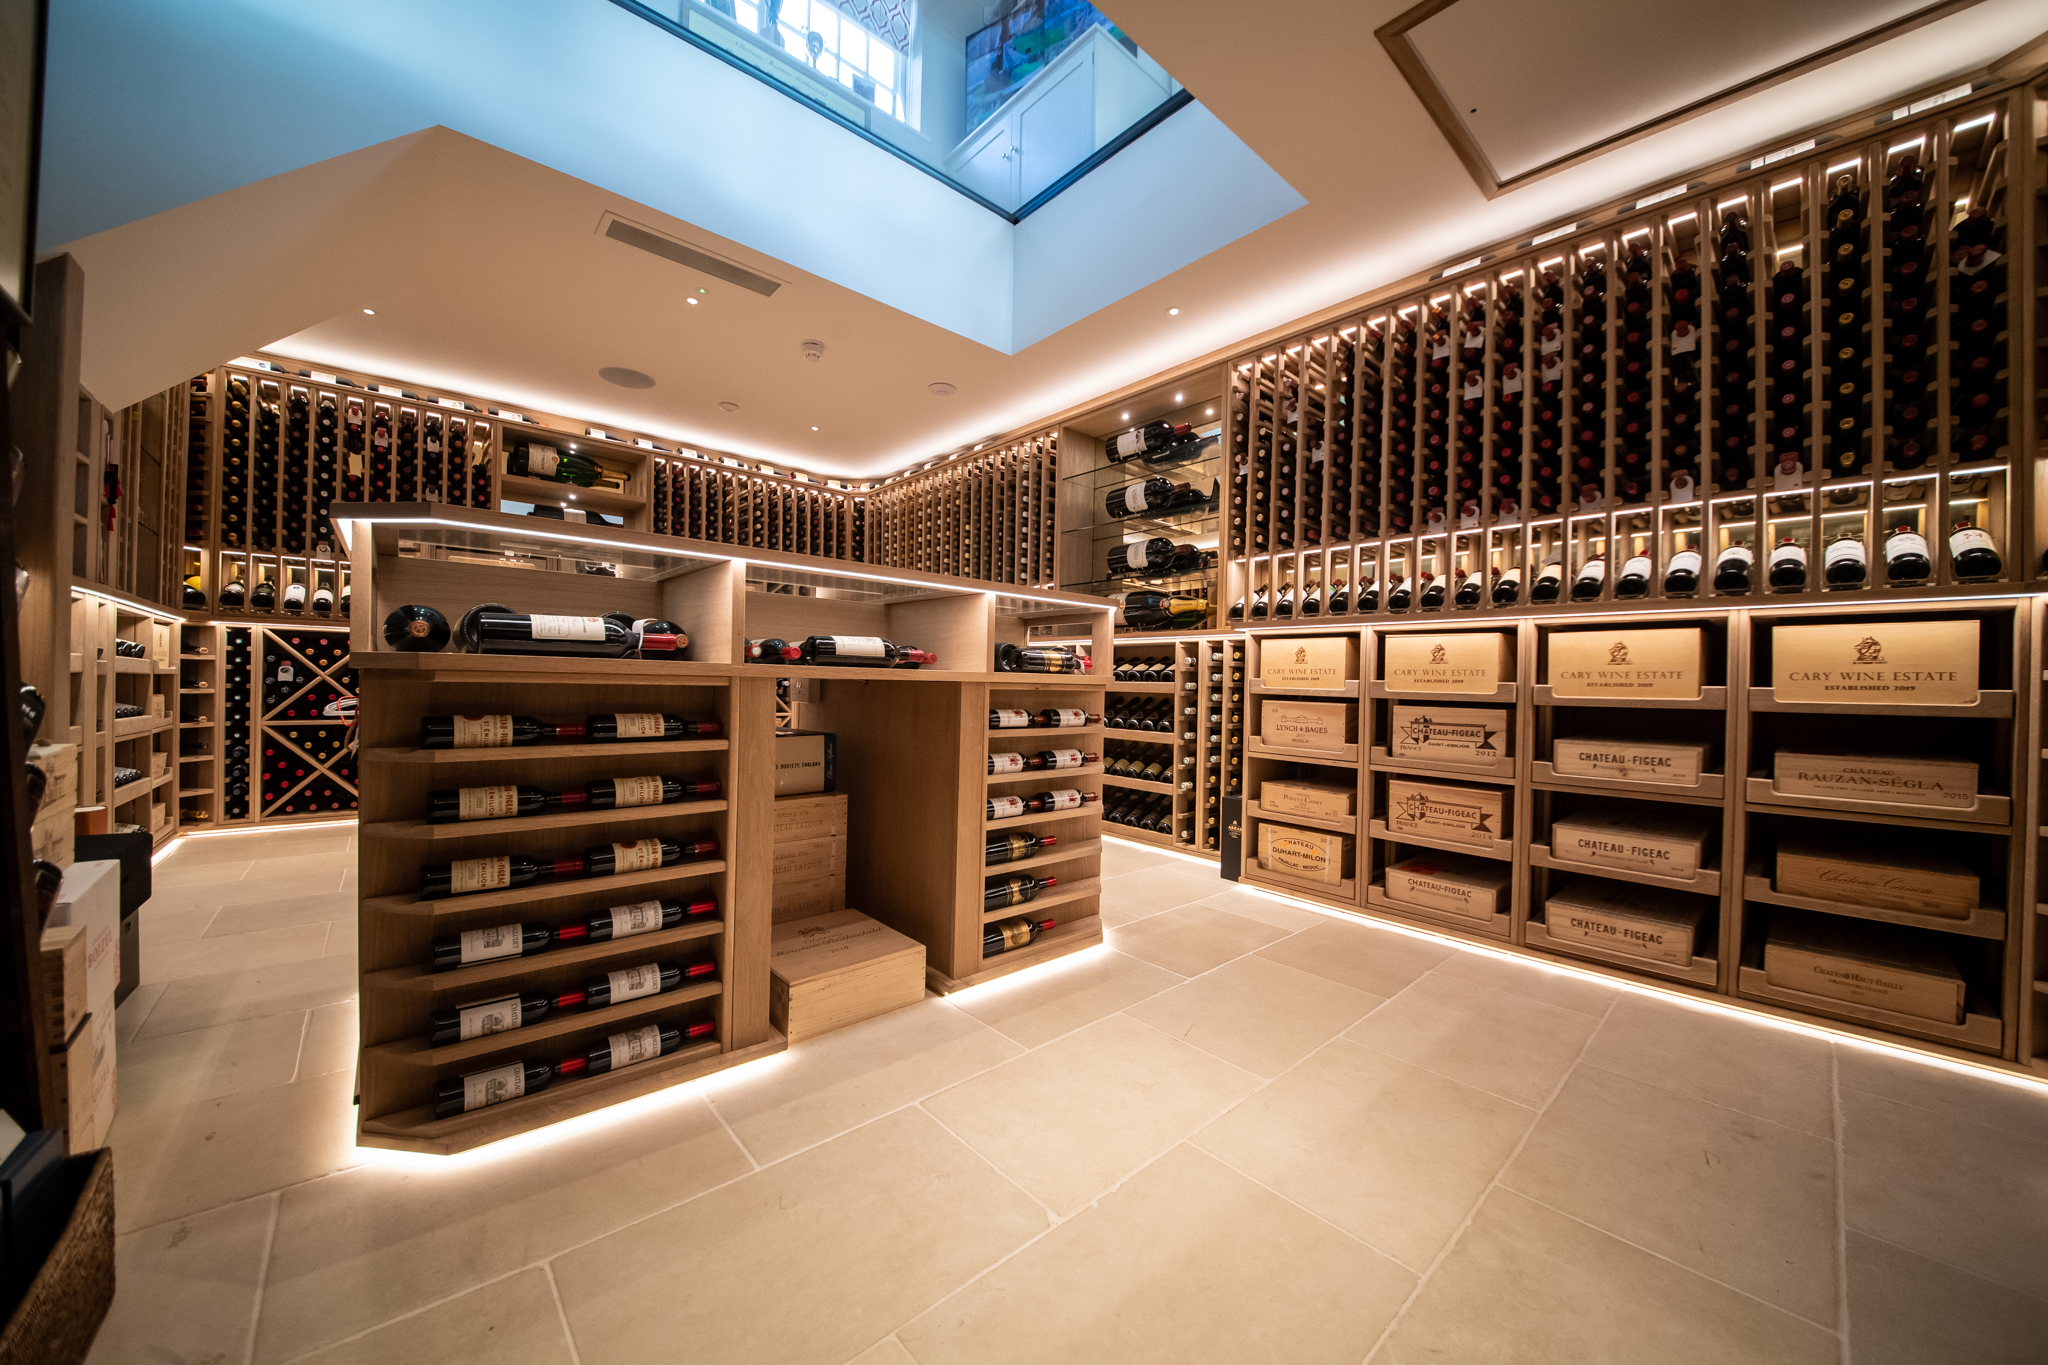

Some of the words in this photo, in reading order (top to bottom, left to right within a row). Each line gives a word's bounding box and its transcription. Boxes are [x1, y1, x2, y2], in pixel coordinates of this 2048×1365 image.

[1394, 669, 1418, 677] CARY
[1422, 669, 1448, 677] WINE
[1451, 669, 1487, 677] ESTATE
[1560, 671, 1593, 680] CARY
[1597, 671, 1631, 680] WINE
[1636, 671, 1684, 680] ESTATE
[1789, 672, 1833, 682] CARY
[1840, 671, 1886, 682] WINE
[1893, 671, 1958, 682] ESTATE
[1276, 724, 1298, 732] LYNCH
[1305, 725, 1328, 734] BAGES
[1412, 727, 1482, 738] CHATEAU-FIGEAC
[1579, 752, 1672, 768] CHATEAU-FIGEAC
[1842, 767, 1895, 777] CHÂTEAU
[1797, 772, 1945, 791] RAUZAN-SÉGLA
[1943, 792, 1969, 800] 2015
[776, 811, 797, 819] GRAND
[1408, 803, 1477, 819] CHATEAU-FIGEAC
[795, 819, 824, 830] LATOUR
[1396, 820, 1419, 829] FRANCE
[1470, 831, 1494, 841] 2014
[1272, 846, 1327, 863] DUHART-MILON
[1577, 838, 1671, 860] CHATEAU-FIGEAC
[776, 853, 797, 861] GRAND
[794, 859, 823, 872] LATOUR
[1408, 878, 1473, 898] CHATEAU-FIGEAC
[793, 900, 822, 912] LATOUR
[1921, 901, 1941, 910] 2016
[1570, 917, 1664, 945] CHATEAU-FIGEAC
[87, 929, 112, 970] BOIZEL
[1851, 972, 1905, 991] HAUT-BAILLY
